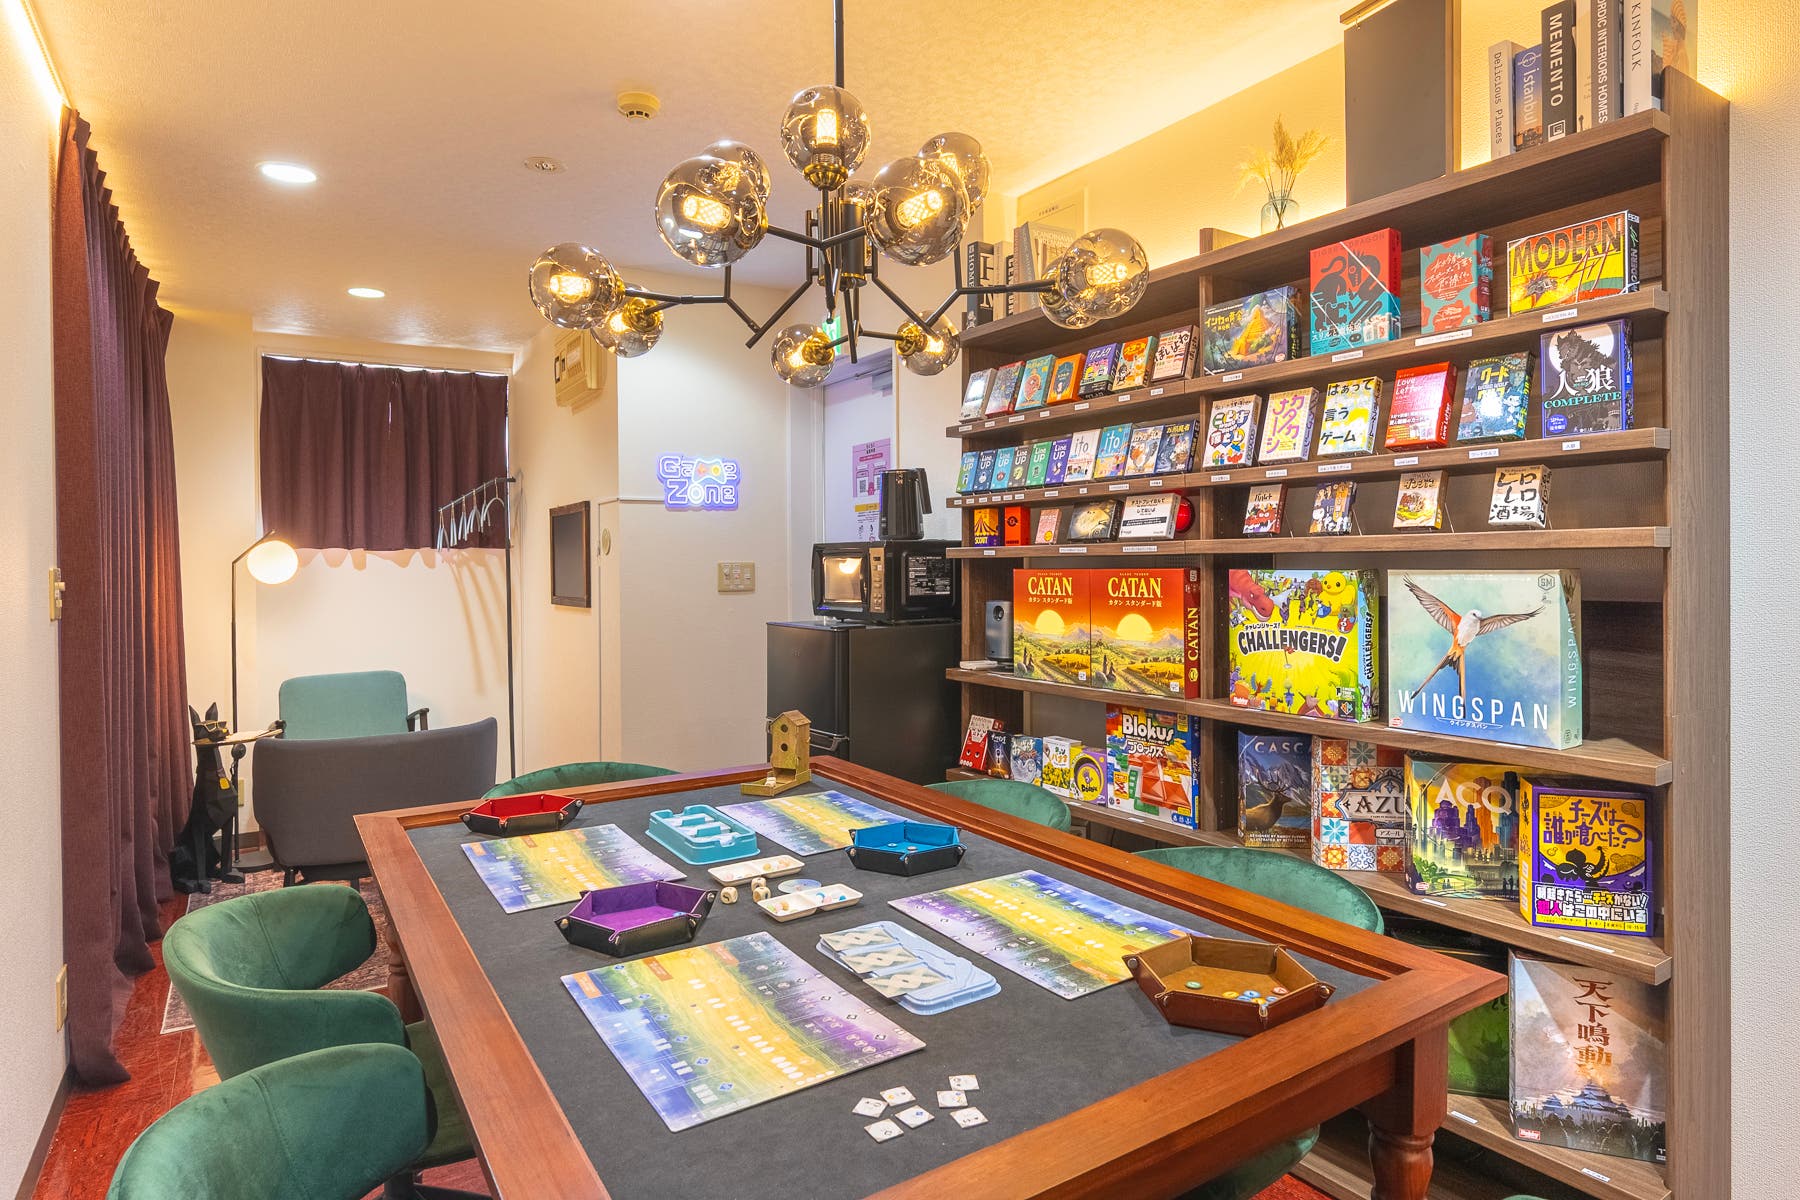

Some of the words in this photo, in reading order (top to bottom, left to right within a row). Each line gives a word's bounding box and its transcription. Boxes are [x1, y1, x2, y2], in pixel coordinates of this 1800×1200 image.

[1597, 0, 1607, 28] RDIC
[1631, 2, 1642, 71] KINFOLK
[1549, 12, 1564, 107] MEMENTO
[1597, 29, 1608, 84] INTERIORS
[1494, 51, 1502, 105] Delicious
[1523, 67, 1540, 125] istanbul
[1598, 84, 1608, 124] HOMES
[1513, 217, 1621, 276] MODERN
[1563, 240, 1618, 303] Art
[1397, 376, 1416, 387] Love
[1480, 366, 1510, 385] ワード
[1550, 364, 1617, 400] 人狼
[1328, 378, 1374, 396] はぁって
[1544, 392, 1622, 409] COMPLETE
[1325, 407, 1349, 422] 言う
[1054, 442, 1067, 452] Line
[1074, 437, 1089, 455] ito
[1105, 431, 1120, 452] ito
[1321, 430, 1356, 445] ゲーム
[1016, 448, 1028, 457] Line
[1033, 453, 1046, 463] UP
[1035, 446, 1047, 455] Line
[1053, 450, 1066, 460] UP
[963, 462, 974, 472] UP
[980, 461, 991, 470] UP
[998, 458, 1010, 468] UP
[1015, 456, 1027, 466] UP
[667, 479, 736, 505] Zone
[974, 536, 988, 545] SCOUT
[1027, 577, 1073, 596] CATAN
[1107, 577, 1162, 599] CATAN
[1042, 597, 1073, 605] スタンダード版
[1108, 599, 1122, 607] カタン
[1125, 600, 1162, 608] スタンダード版
[1187, 607, 1199, 661] CATAN
[1245, 622, 1281, 631] チャレンジャーズ!
[1238, 630, 1348, 662] CHALLENGERS!
[1366, 612, 1374, 680] CHALLENGERS!
[1567, 612, 1577, 709] WINGSPAN
[1398, 689, 1548, 730] WINGSPAN
[1122, 713, 1174, 742] Blokus
[1127, 741, 1165, 758] ブロックス
[1254, 741, 1310, 754] CASC
[1568, 799, 1625, 826] チーズは
[1573, 976, 1613, 1068] 天下鳴動
